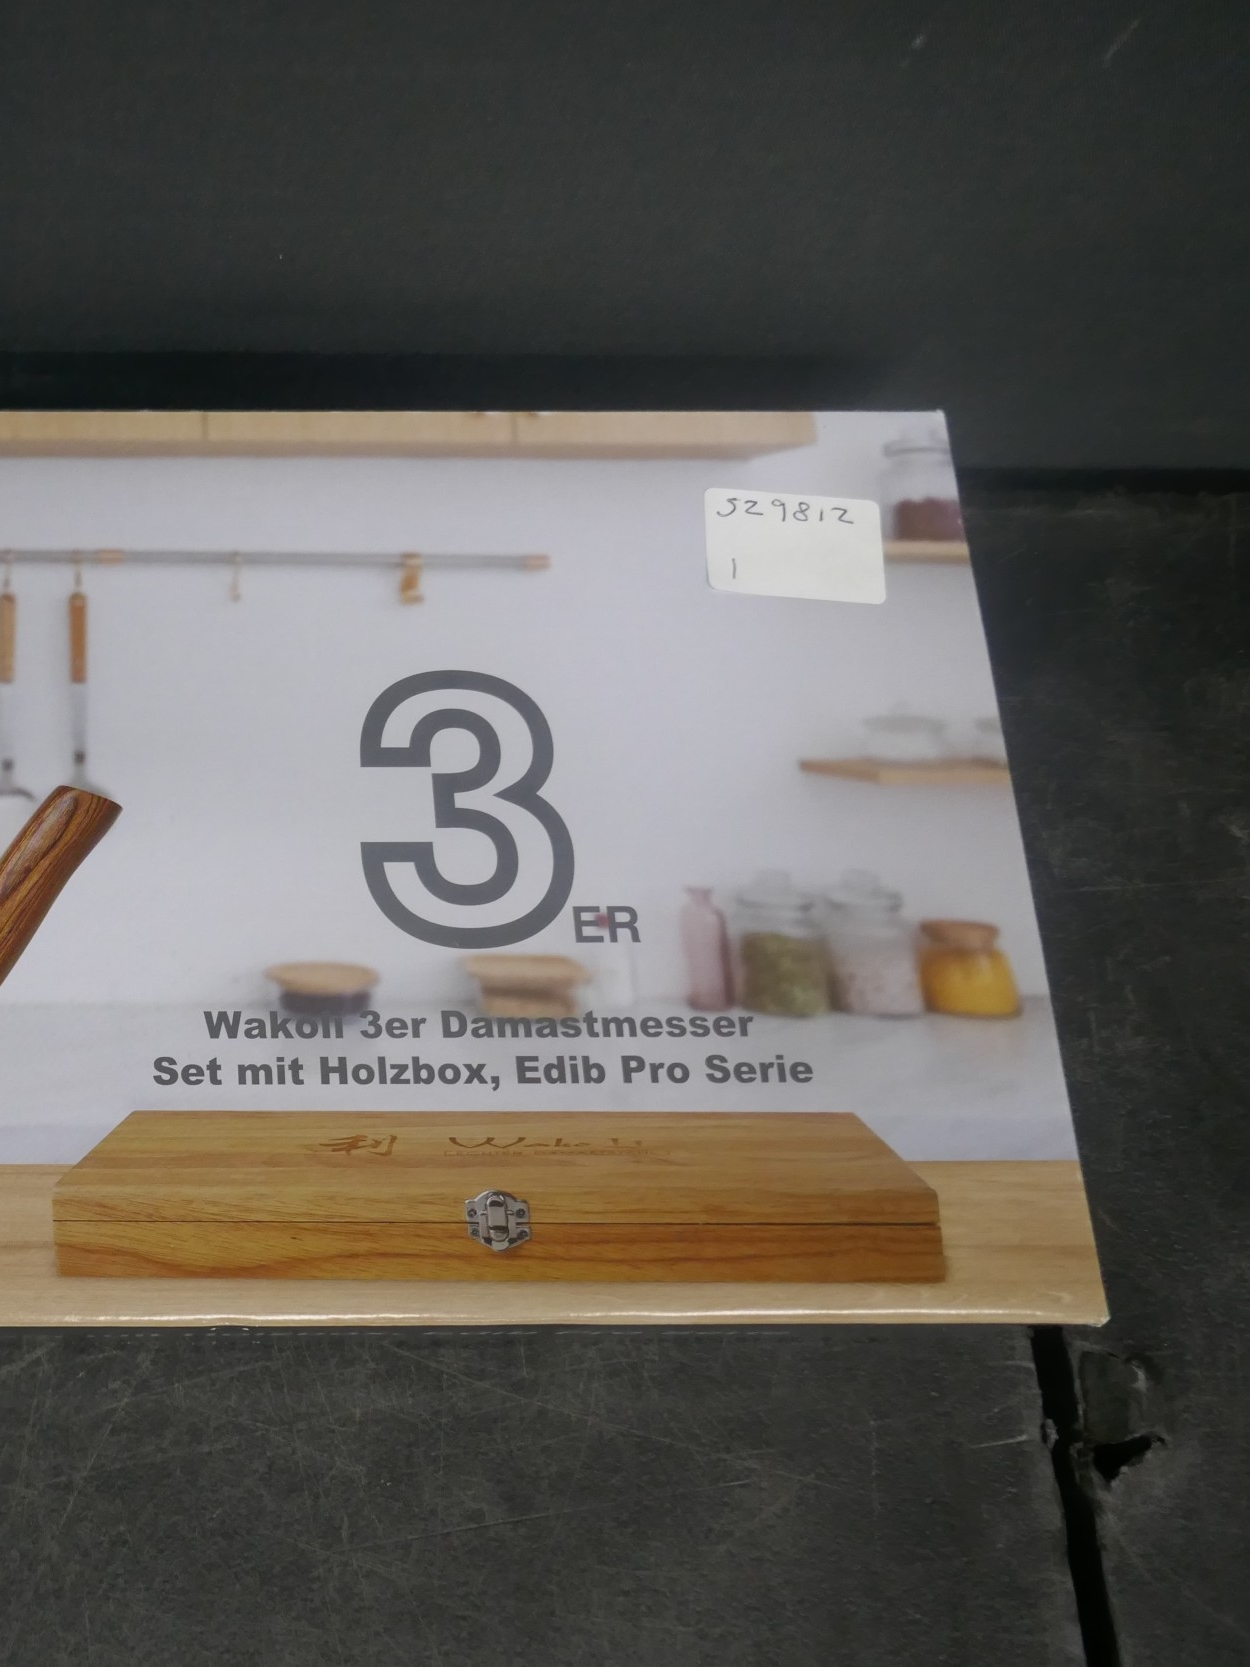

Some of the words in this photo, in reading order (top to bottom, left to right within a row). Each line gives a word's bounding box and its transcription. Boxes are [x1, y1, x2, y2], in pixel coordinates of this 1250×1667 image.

[715, 496, 856, 525] 529812
[358, 1009, 427, 1040] 3er
[440, 1009, 754, 1040] Damastmesser
[152, 1056, 223, 1086] Set
[236, 1056, 305, 1086] mit
[318, 1056, 501, 1092] Holzbox,
[514, 1055, 607, 1085] Edib
[620, 1055, 691, 1084] Pro
[704, 1053, 815, 1084] Serie
